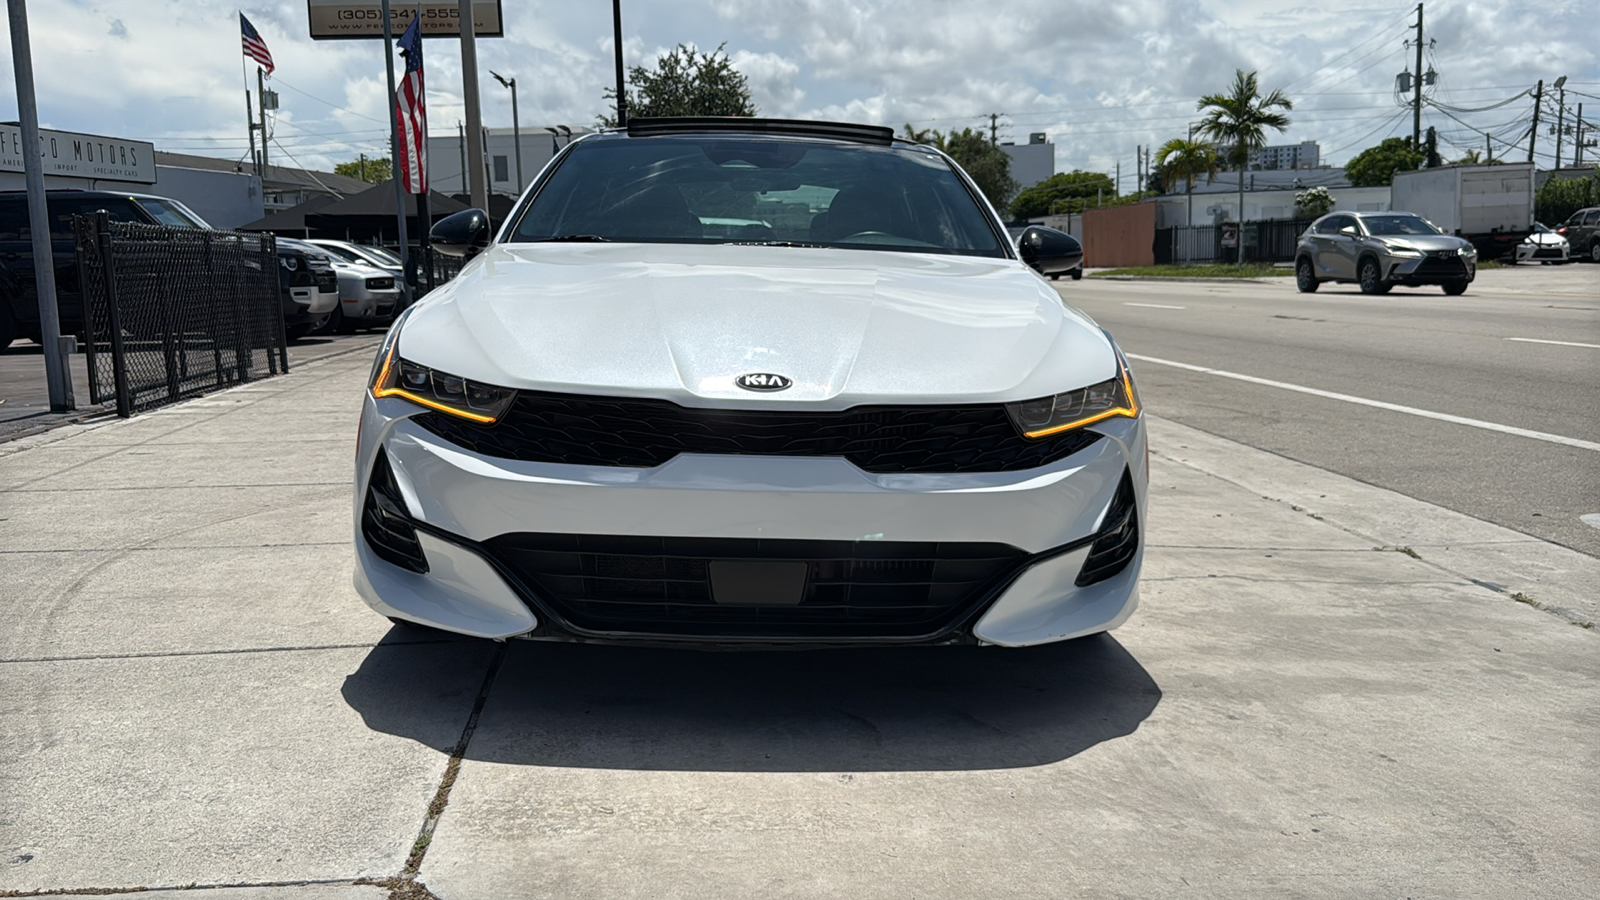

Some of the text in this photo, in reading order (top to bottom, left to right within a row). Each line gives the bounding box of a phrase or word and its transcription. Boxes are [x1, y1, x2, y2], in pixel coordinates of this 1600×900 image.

[338, 8, 461, 20] (305) 541-555
[0, 131, 137, 167] FECO MOTORS
[54, 163, 78, 171] IMPORT
[93, 167, 123, 176] SPECIALTY
[745, 374, 783, 386] KIA
